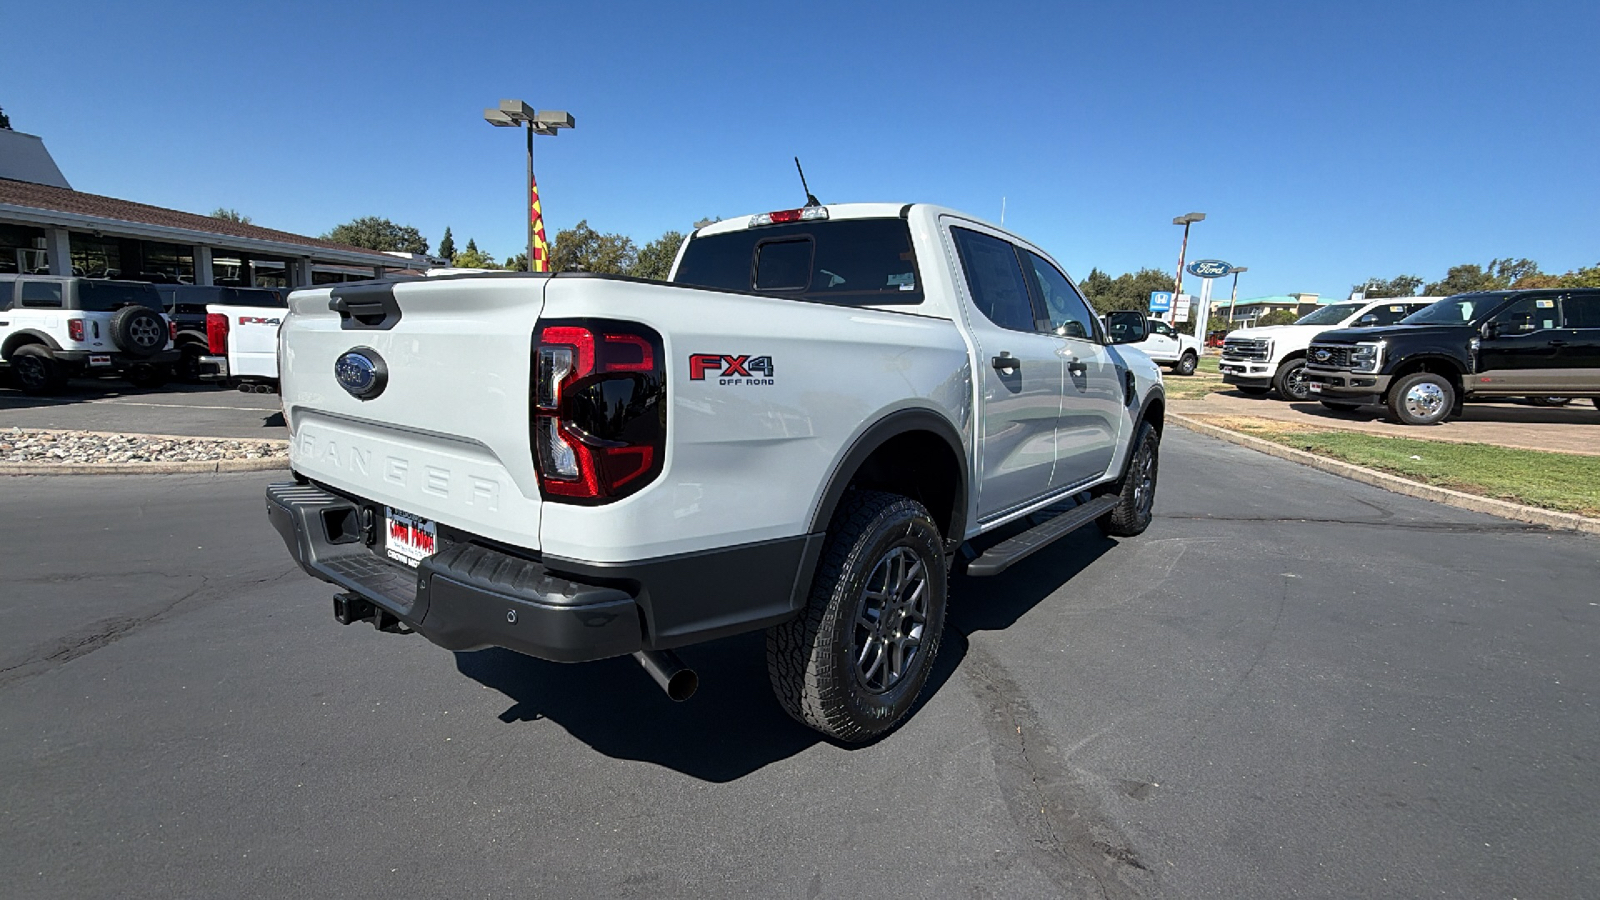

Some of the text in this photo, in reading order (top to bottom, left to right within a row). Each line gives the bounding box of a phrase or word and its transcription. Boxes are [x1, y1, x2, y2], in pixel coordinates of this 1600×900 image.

[1197, 263, 1225, 274] Ford
[239, 316, 280, 325] FX4
[689, 353, 774, 381] FX4
[301, 433, 499, 512] RANGER
